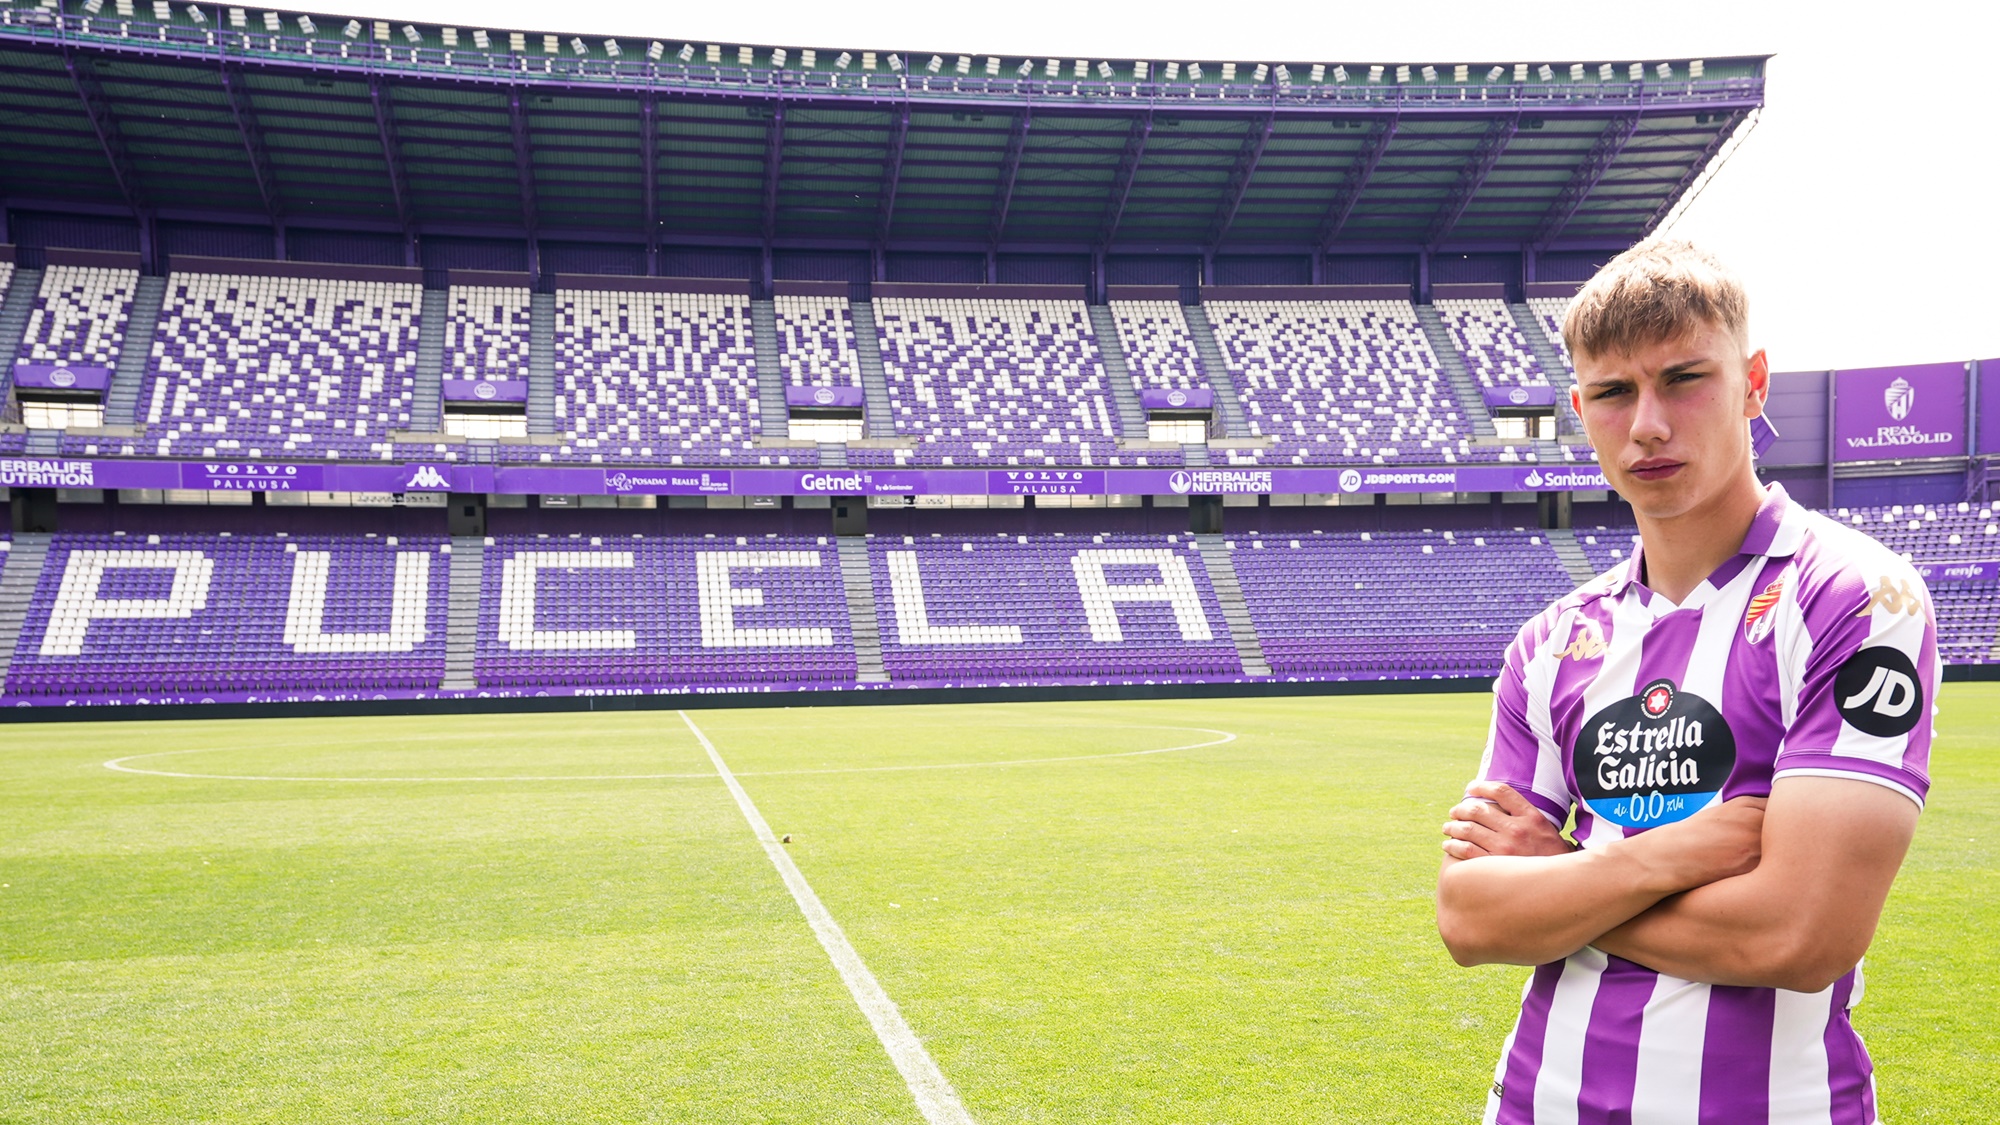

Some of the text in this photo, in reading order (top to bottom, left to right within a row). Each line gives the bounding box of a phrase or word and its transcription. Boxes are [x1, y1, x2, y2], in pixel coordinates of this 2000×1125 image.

[1877, 425, 1920, 437] REAL
[1847, 432, 1953, 447] VALLADOLID
[0, 460, 93, 474] ERBALIFE
[205, 464, 298, 475] VOLVO
[0, 472, 94, 486] UTRITION
[632, 477, 699, 486] POSADAS REALES
[801, 473, 862, 491] Getnet
[1007, 472, 1083, 480] VOLVO
[1192, 471, 1272, 482] HERBALIFE
[1363, 473, 1455, 484] JDSPORTS.COM
[1544, 472, 1612, 487] Santand
[213, 479, 290, 489] PALAUSA
[1013, 485, 1076, 493] PALAUSA
[1192, 482, 1272, 492] NUTRITION
[1944, 564, 1983, 578] renfe
[40, 549, 1213, 655] PUCELA
[1843, 665, 1916, 718] JD
[1594, 716, 1704, 756] Estrella
[1597, 751, 1700, 790] Galicia
[1630, 790, 1665, 822] 0,0
